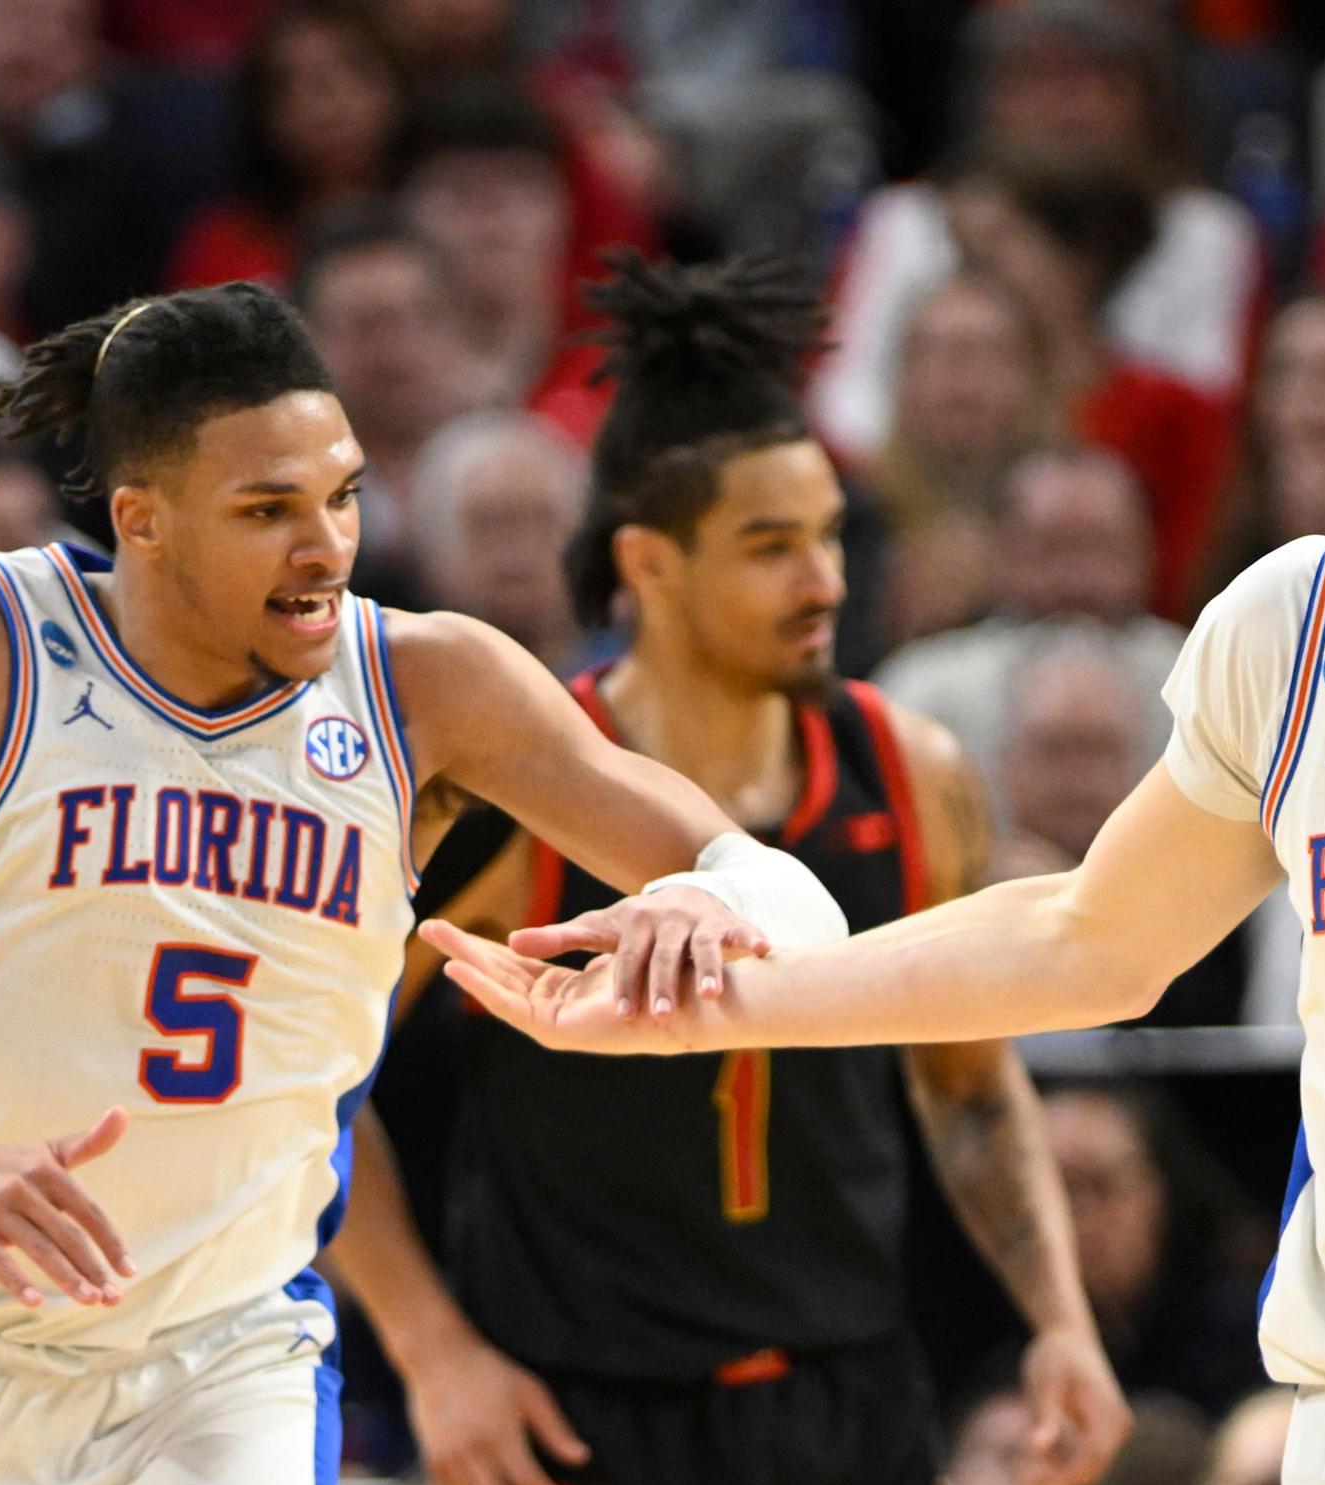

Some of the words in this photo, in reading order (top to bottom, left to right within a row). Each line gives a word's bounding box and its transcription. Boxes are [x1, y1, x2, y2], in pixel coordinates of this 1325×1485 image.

[307, 719, 366, 777] SEC
[49, 784, 362, 928] FLORIDA
[139, 942, 259, 1105] 5
[712, 1047, 772, 1224] 1
